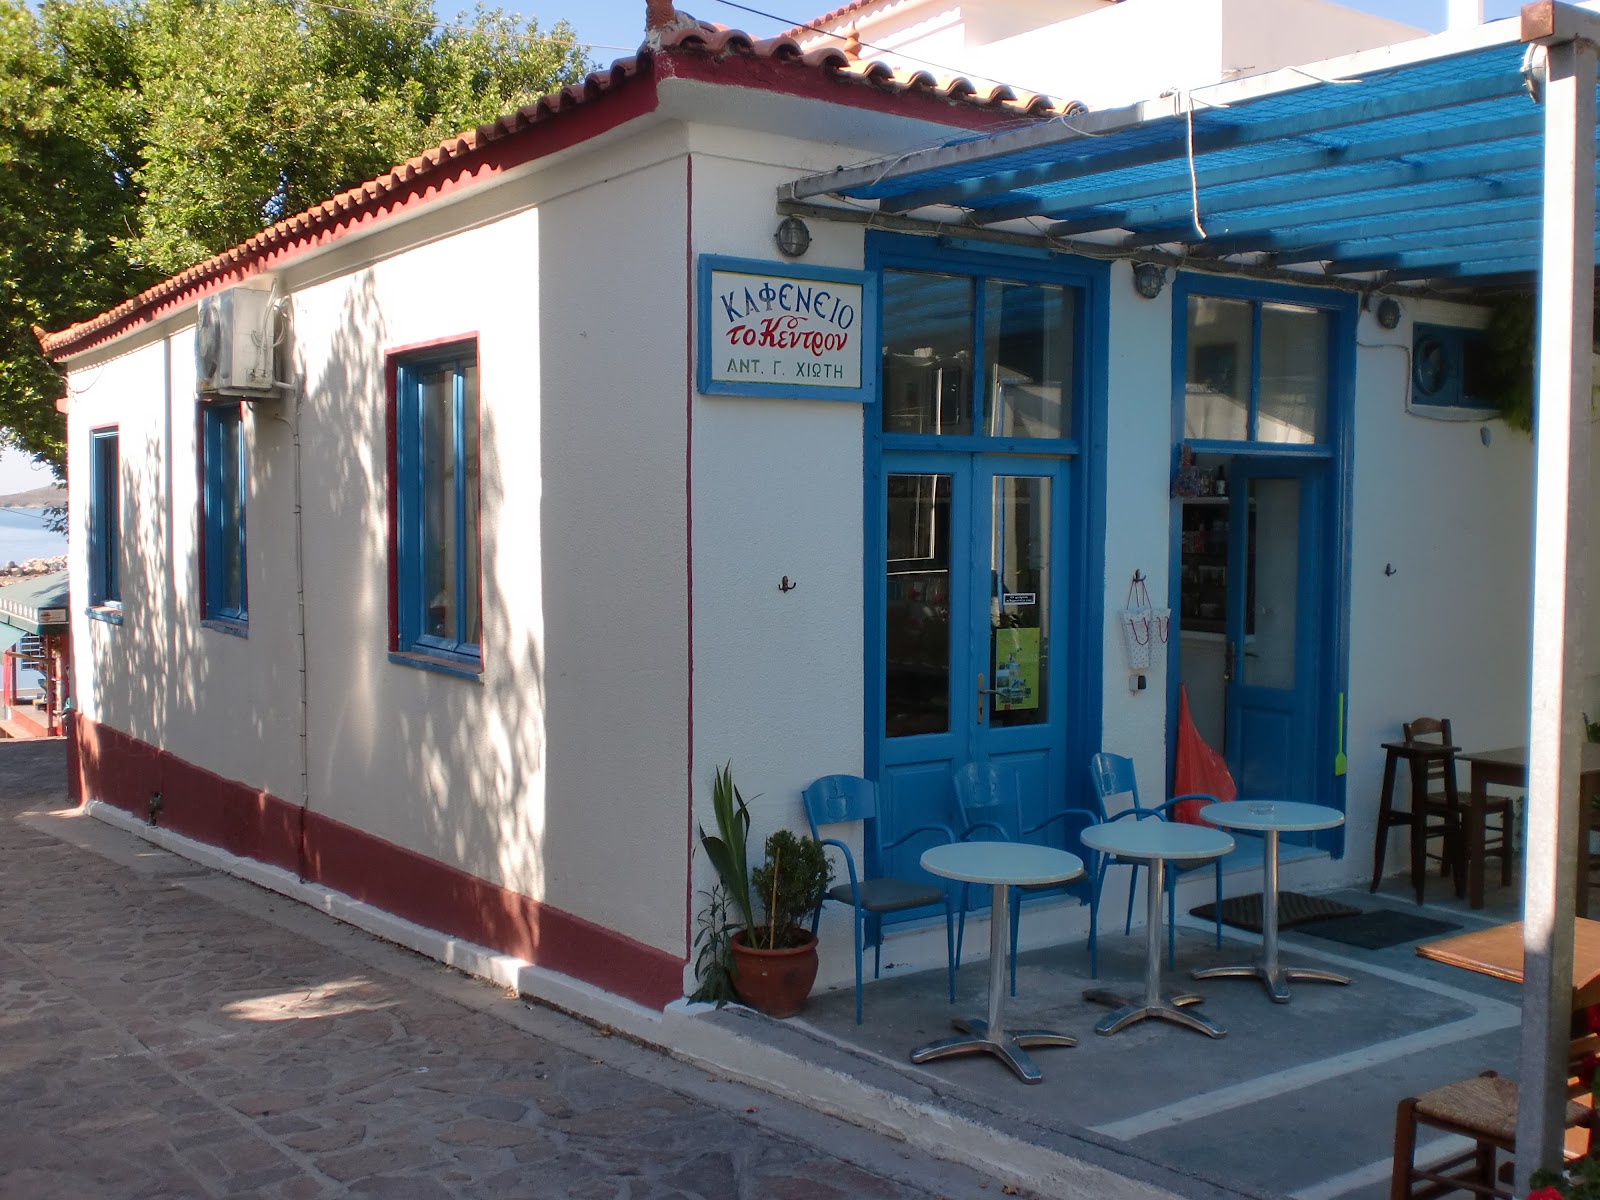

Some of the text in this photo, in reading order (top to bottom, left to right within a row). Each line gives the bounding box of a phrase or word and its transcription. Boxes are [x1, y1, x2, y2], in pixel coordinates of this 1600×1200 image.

[720, 282, 854, 329] ΚΑΦΕΝΕΙΟ
[726, 324, 757, 346] το
[726, 358, 843, 379] ΑΝΤ. Γ. ΧΙΩΤΗ
